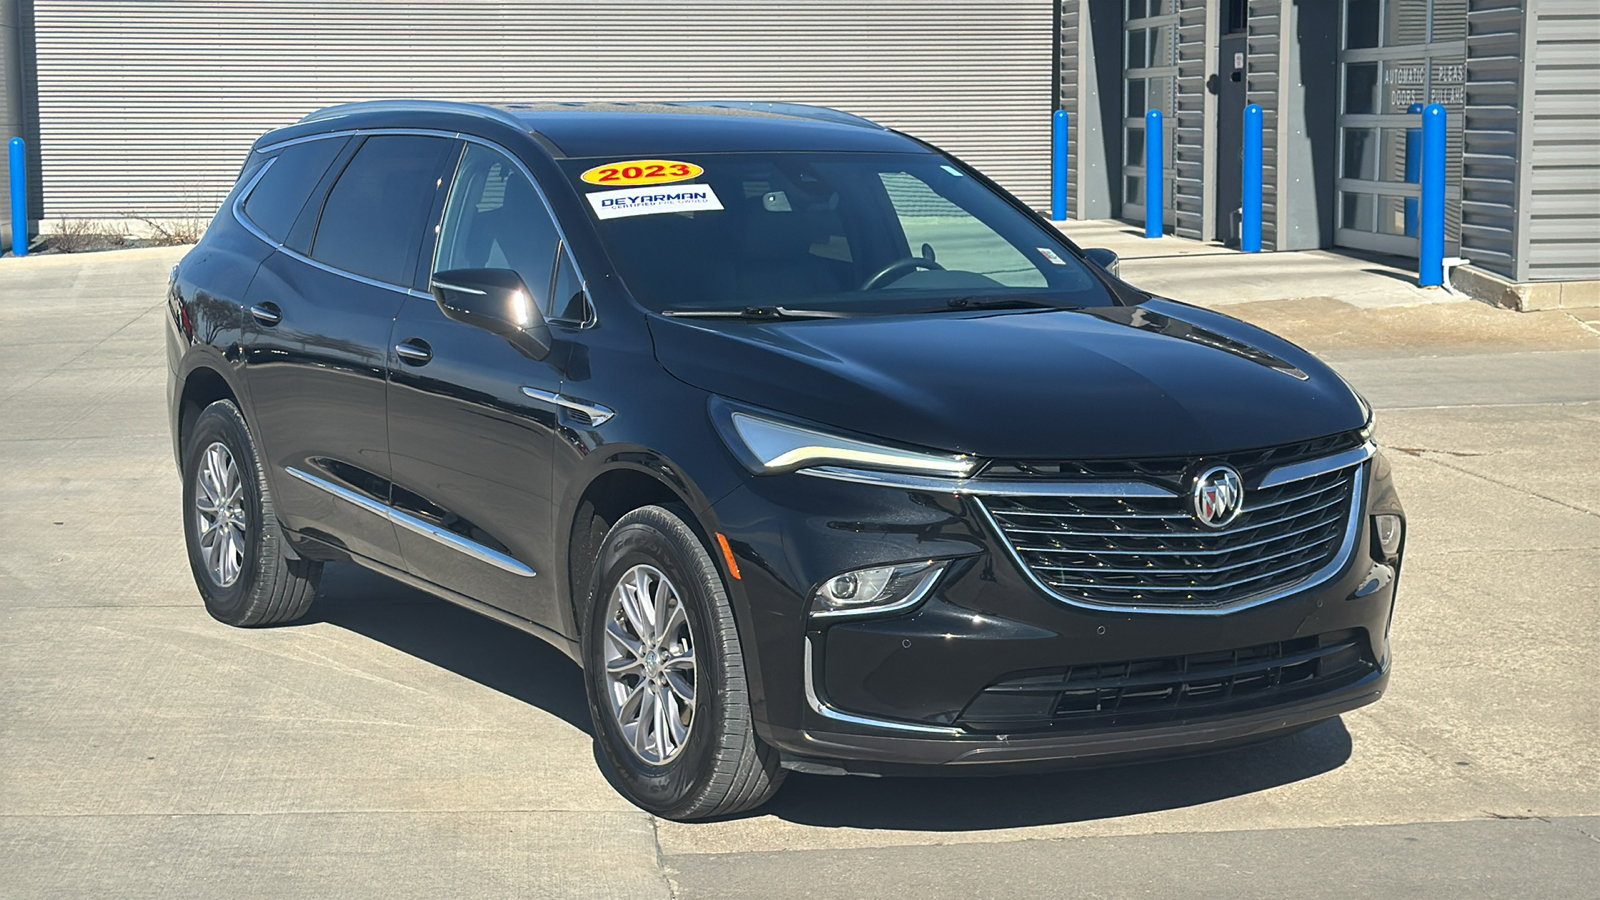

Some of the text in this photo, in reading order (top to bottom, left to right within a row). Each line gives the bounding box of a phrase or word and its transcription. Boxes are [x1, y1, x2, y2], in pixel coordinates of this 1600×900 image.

[1384, 68, 1424, 84] AUTOMATIC
[1438, 66, 1464, 82] PLEAS
[1391, 90, 1416, 105] DOORS
[1431, 88, 1464, 104] PULL AHE
[598, 164, 690, 182] 2023
[601, 192, 706, 207] DEYARMAN
[611, 201, 656, 210] CERTIFIED
